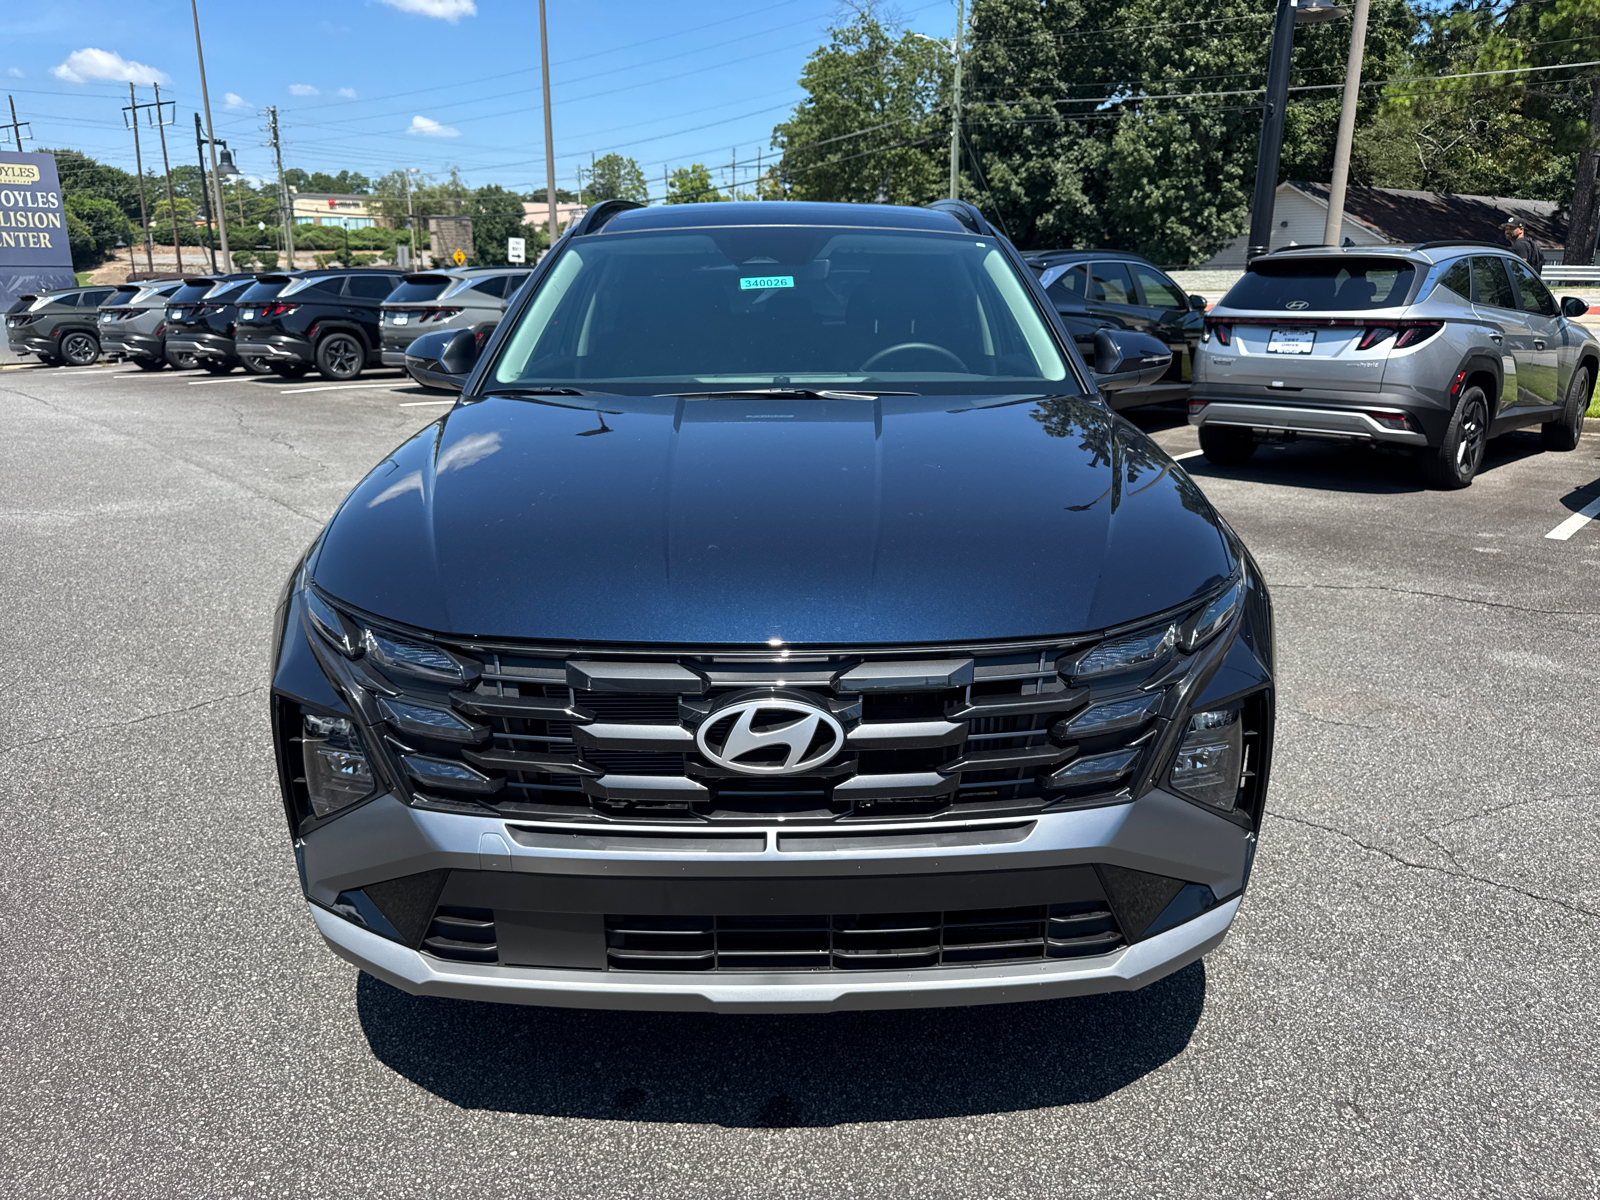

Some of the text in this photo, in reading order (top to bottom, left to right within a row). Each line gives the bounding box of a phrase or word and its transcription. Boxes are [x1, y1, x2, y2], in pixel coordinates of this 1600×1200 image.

[0, 167, 35, 178] YLES
[1, 190, 59, 209] OYLES
[0, 231, 53, 248] NTER
[745, 279, 788, 288] 340026
